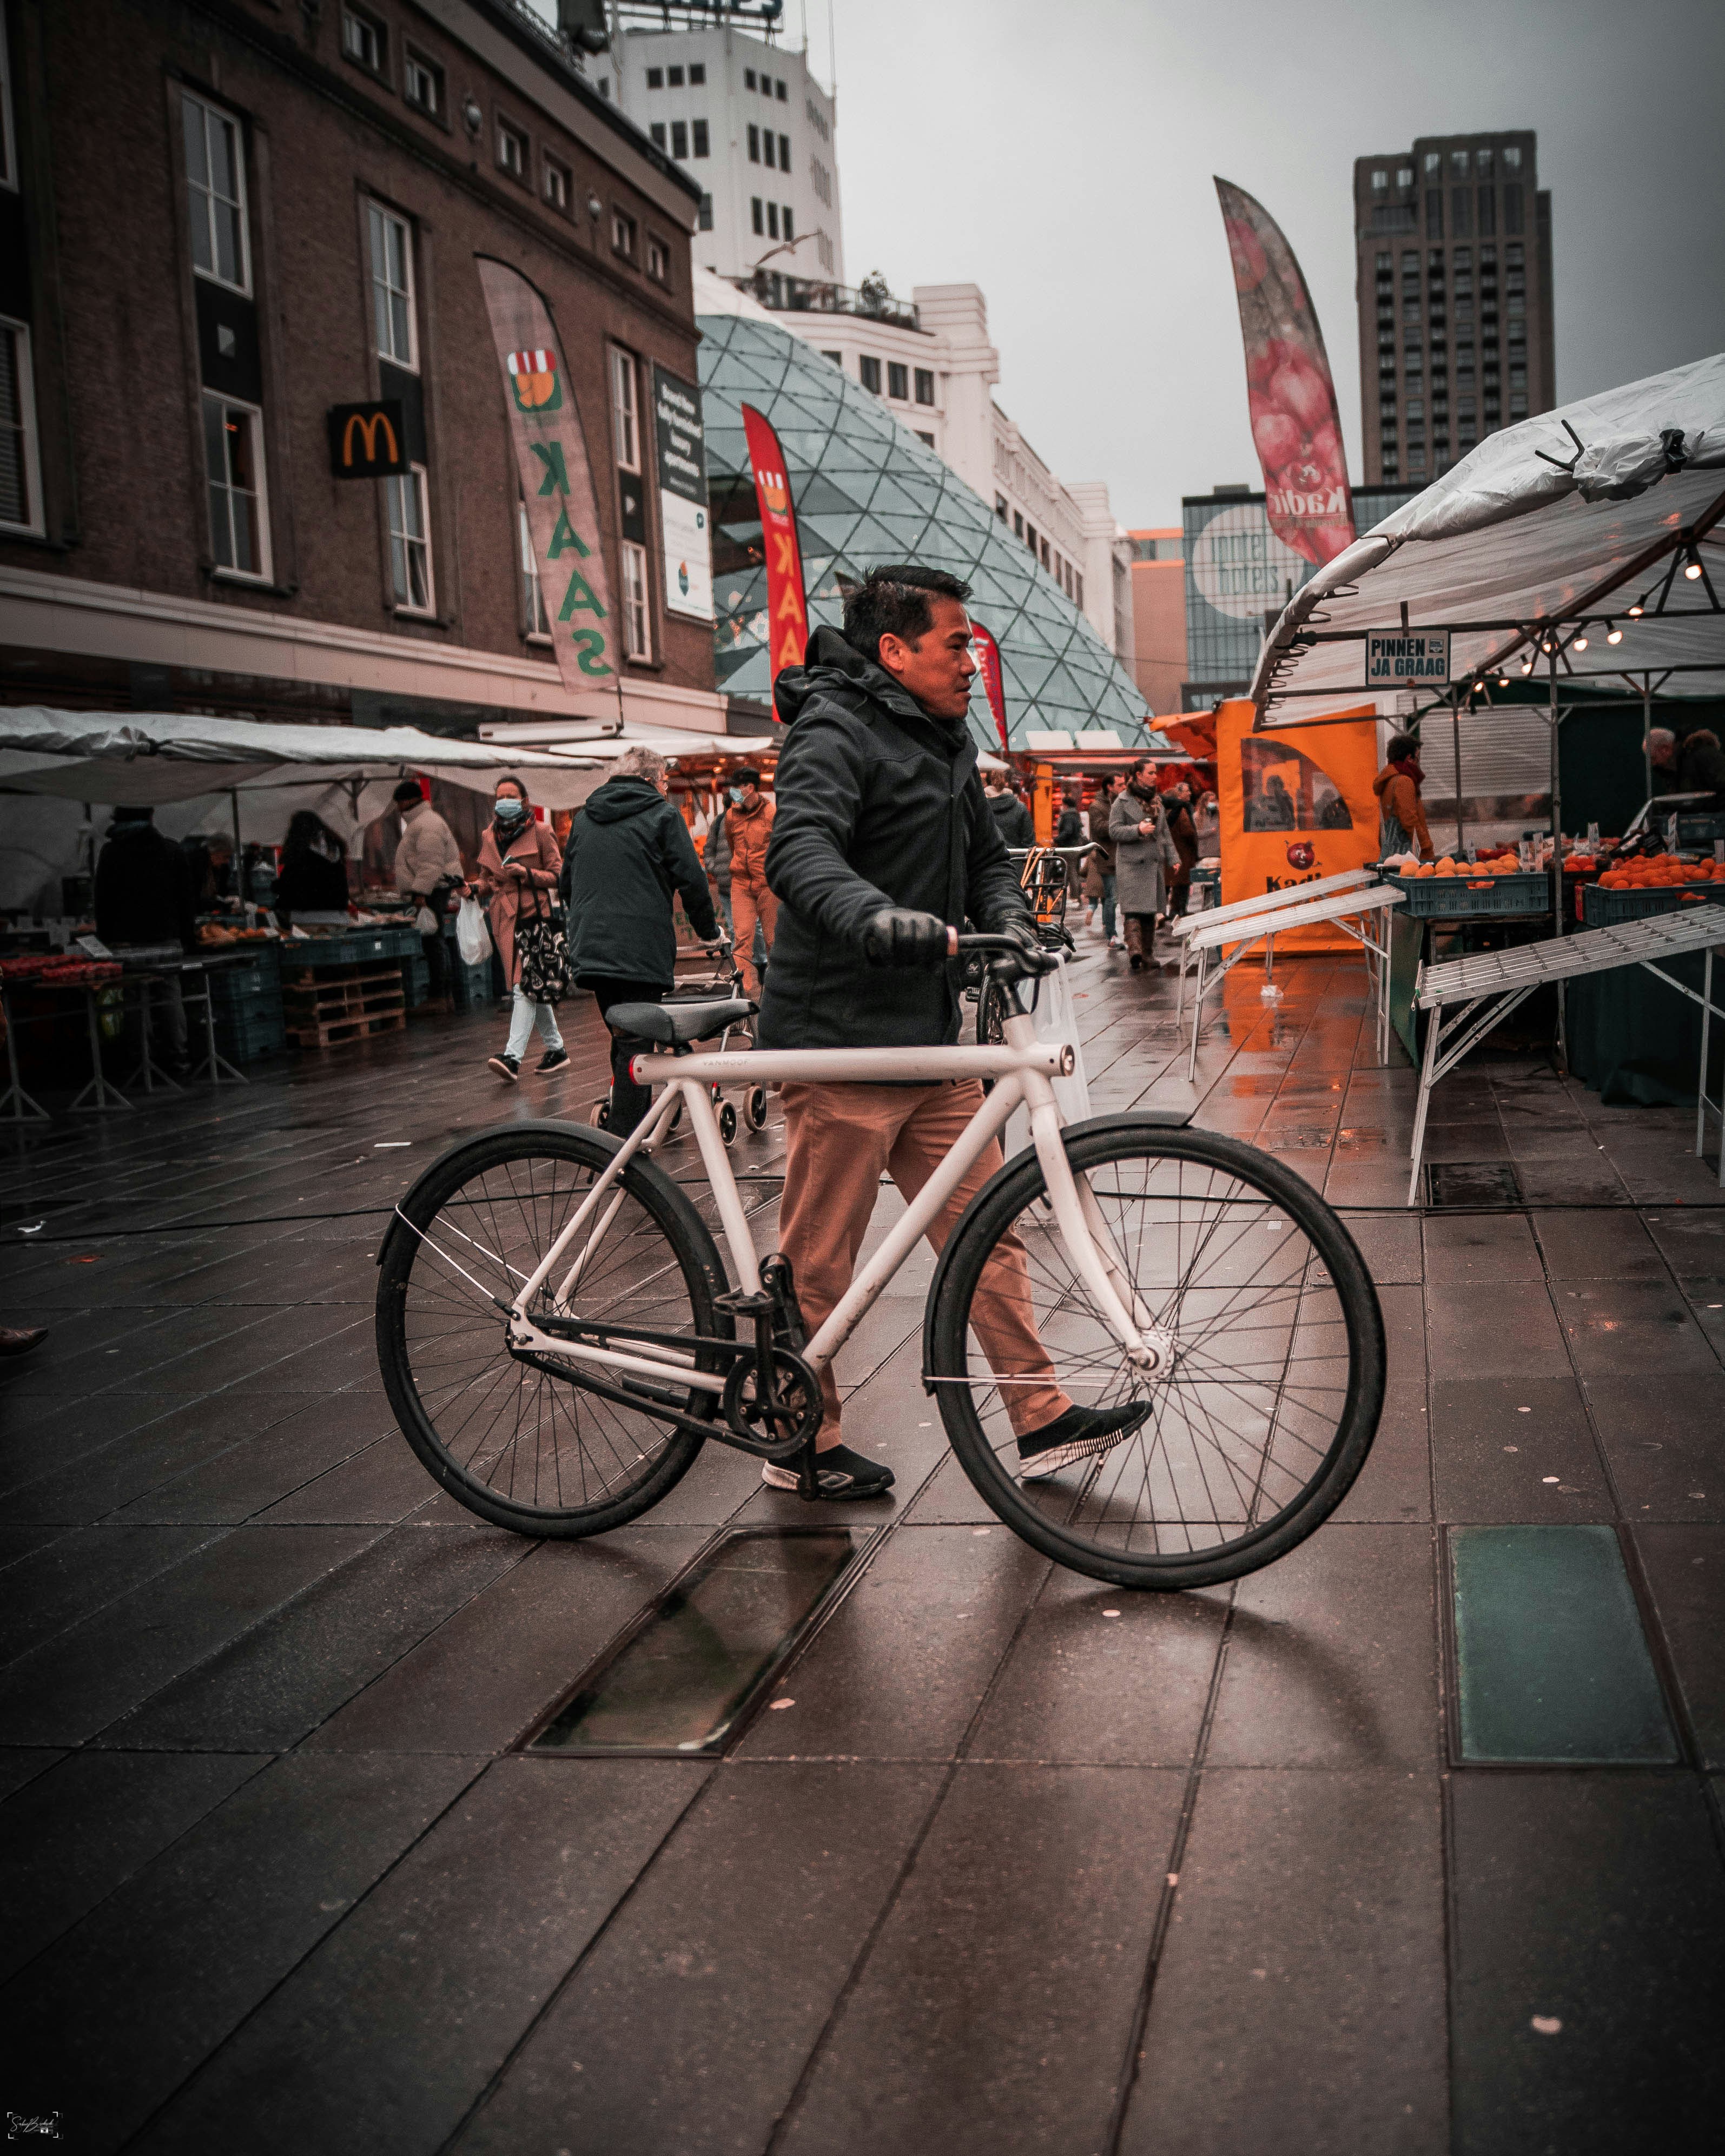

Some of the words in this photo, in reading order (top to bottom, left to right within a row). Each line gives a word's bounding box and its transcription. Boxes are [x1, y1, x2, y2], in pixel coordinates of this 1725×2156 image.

[1371, 639, 1425, 657] PINNEN
[1371, 658, 1391, 676] JA
[1394, 658, 1445, 676] GRAAG
